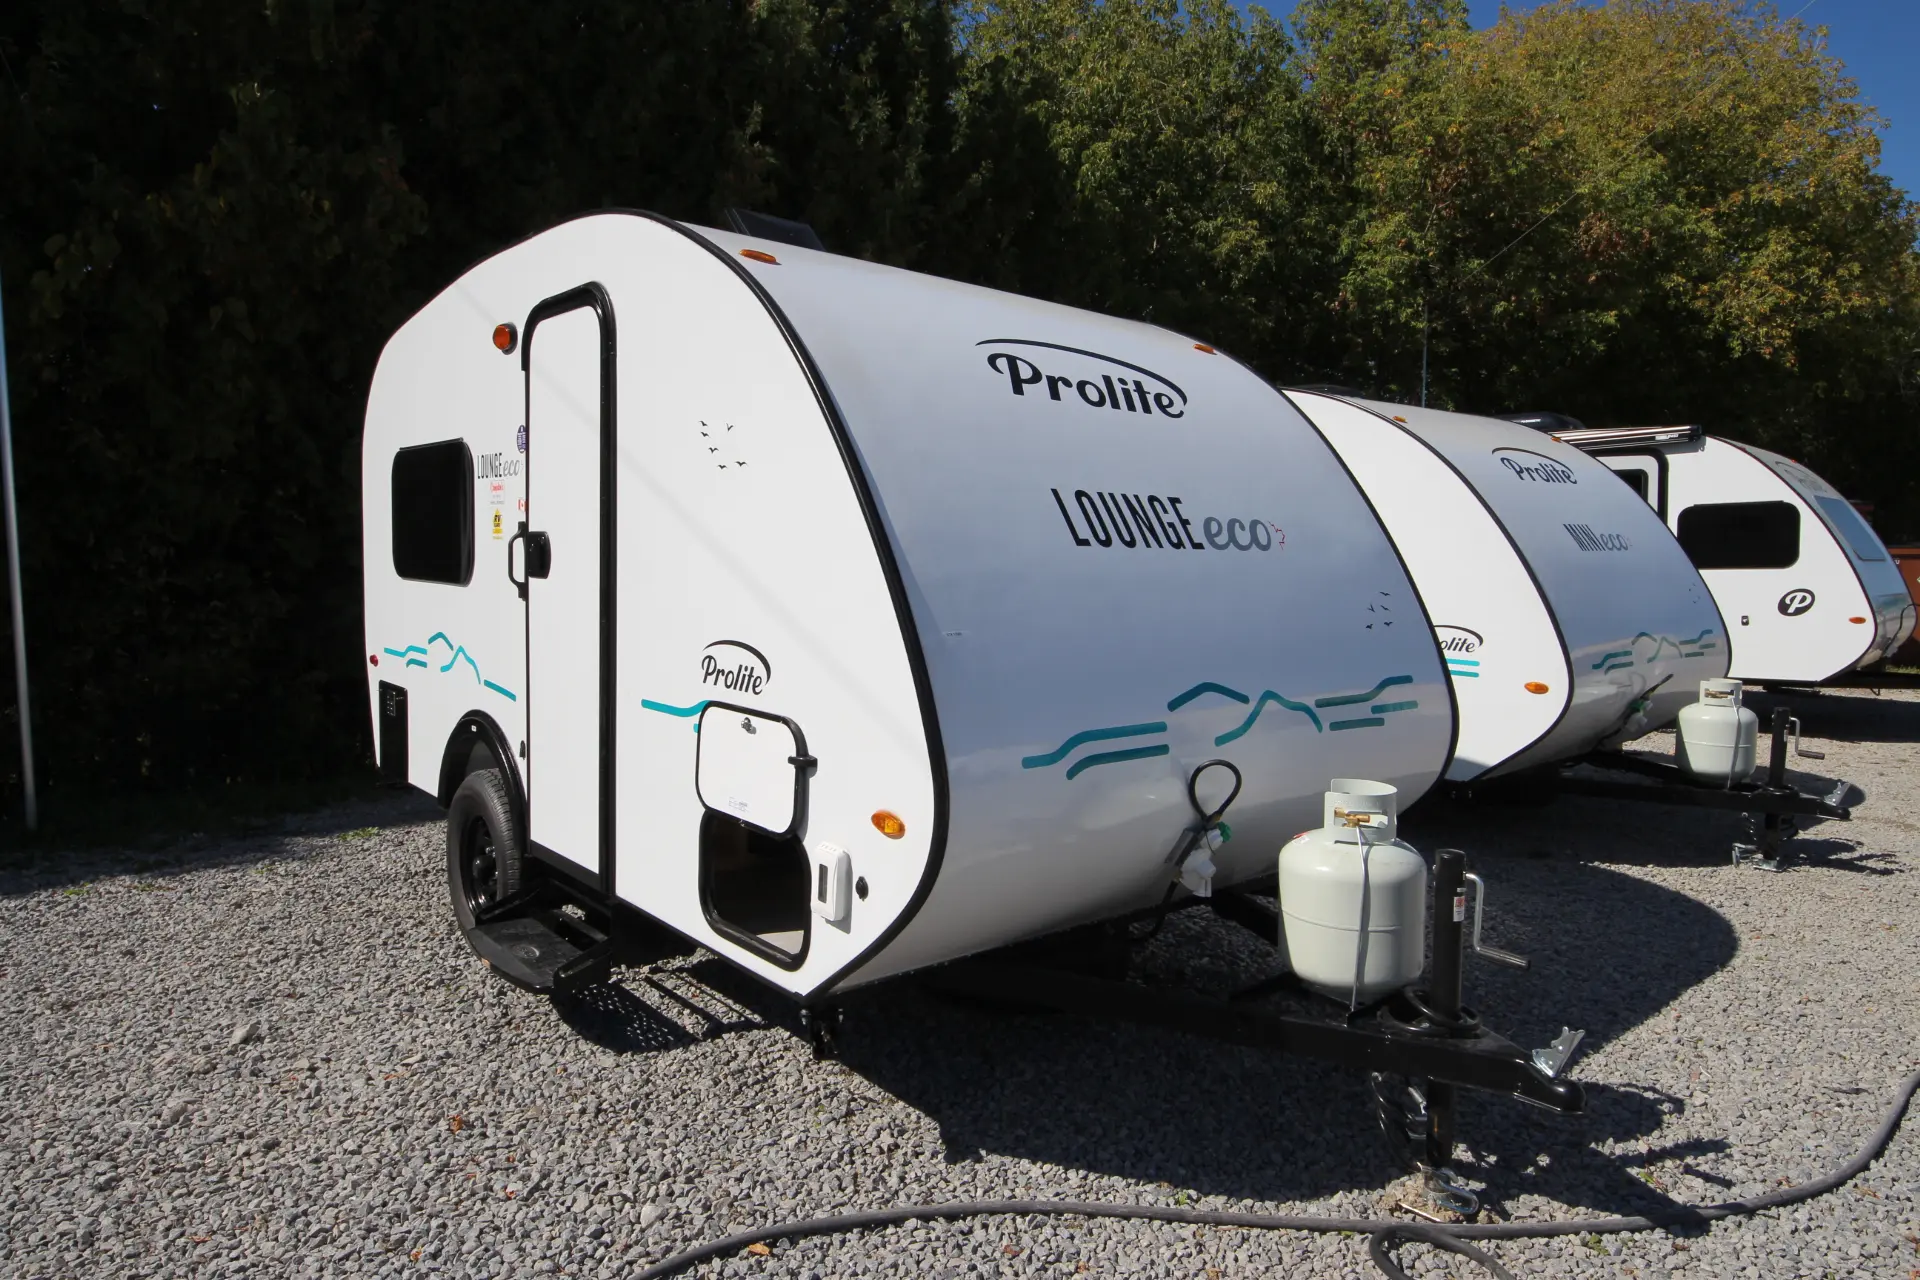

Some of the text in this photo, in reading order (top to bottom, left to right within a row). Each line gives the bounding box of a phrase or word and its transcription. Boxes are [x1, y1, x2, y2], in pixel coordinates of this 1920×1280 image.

[986, 352, 1185, 419] Prolite
[1500, 456, 1577, 485] Prolite
[1783, 590, 1813, 615] P
[1440, 636, 1476, 653] olite
[701, 654, 763, 696] Prolite
